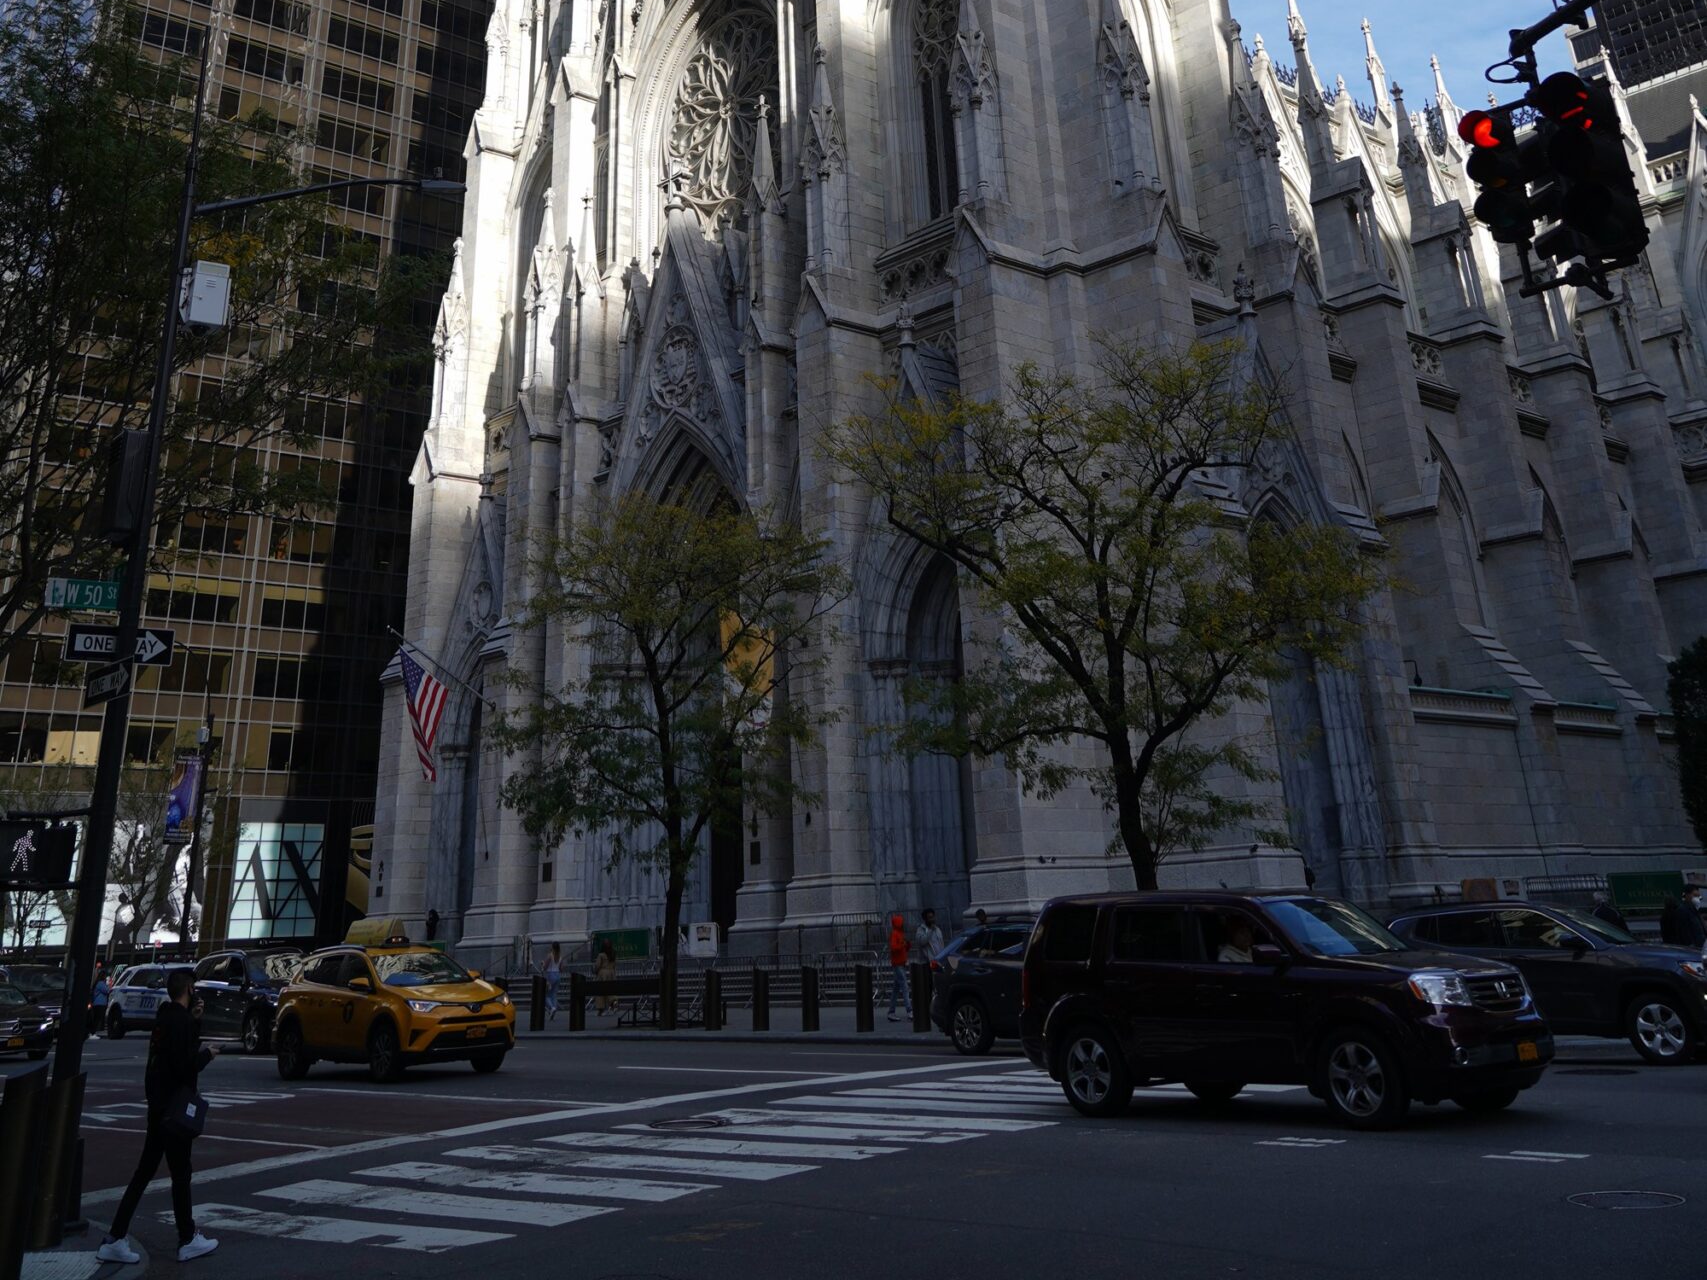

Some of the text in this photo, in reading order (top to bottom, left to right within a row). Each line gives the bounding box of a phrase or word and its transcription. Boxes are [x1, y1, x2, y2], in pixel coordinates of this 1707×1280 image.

[67, 583, 118, 606] W 50 St
[84, 636, 158, 654] ONE AY
[92, 671, 126, 694] ONE WAY
